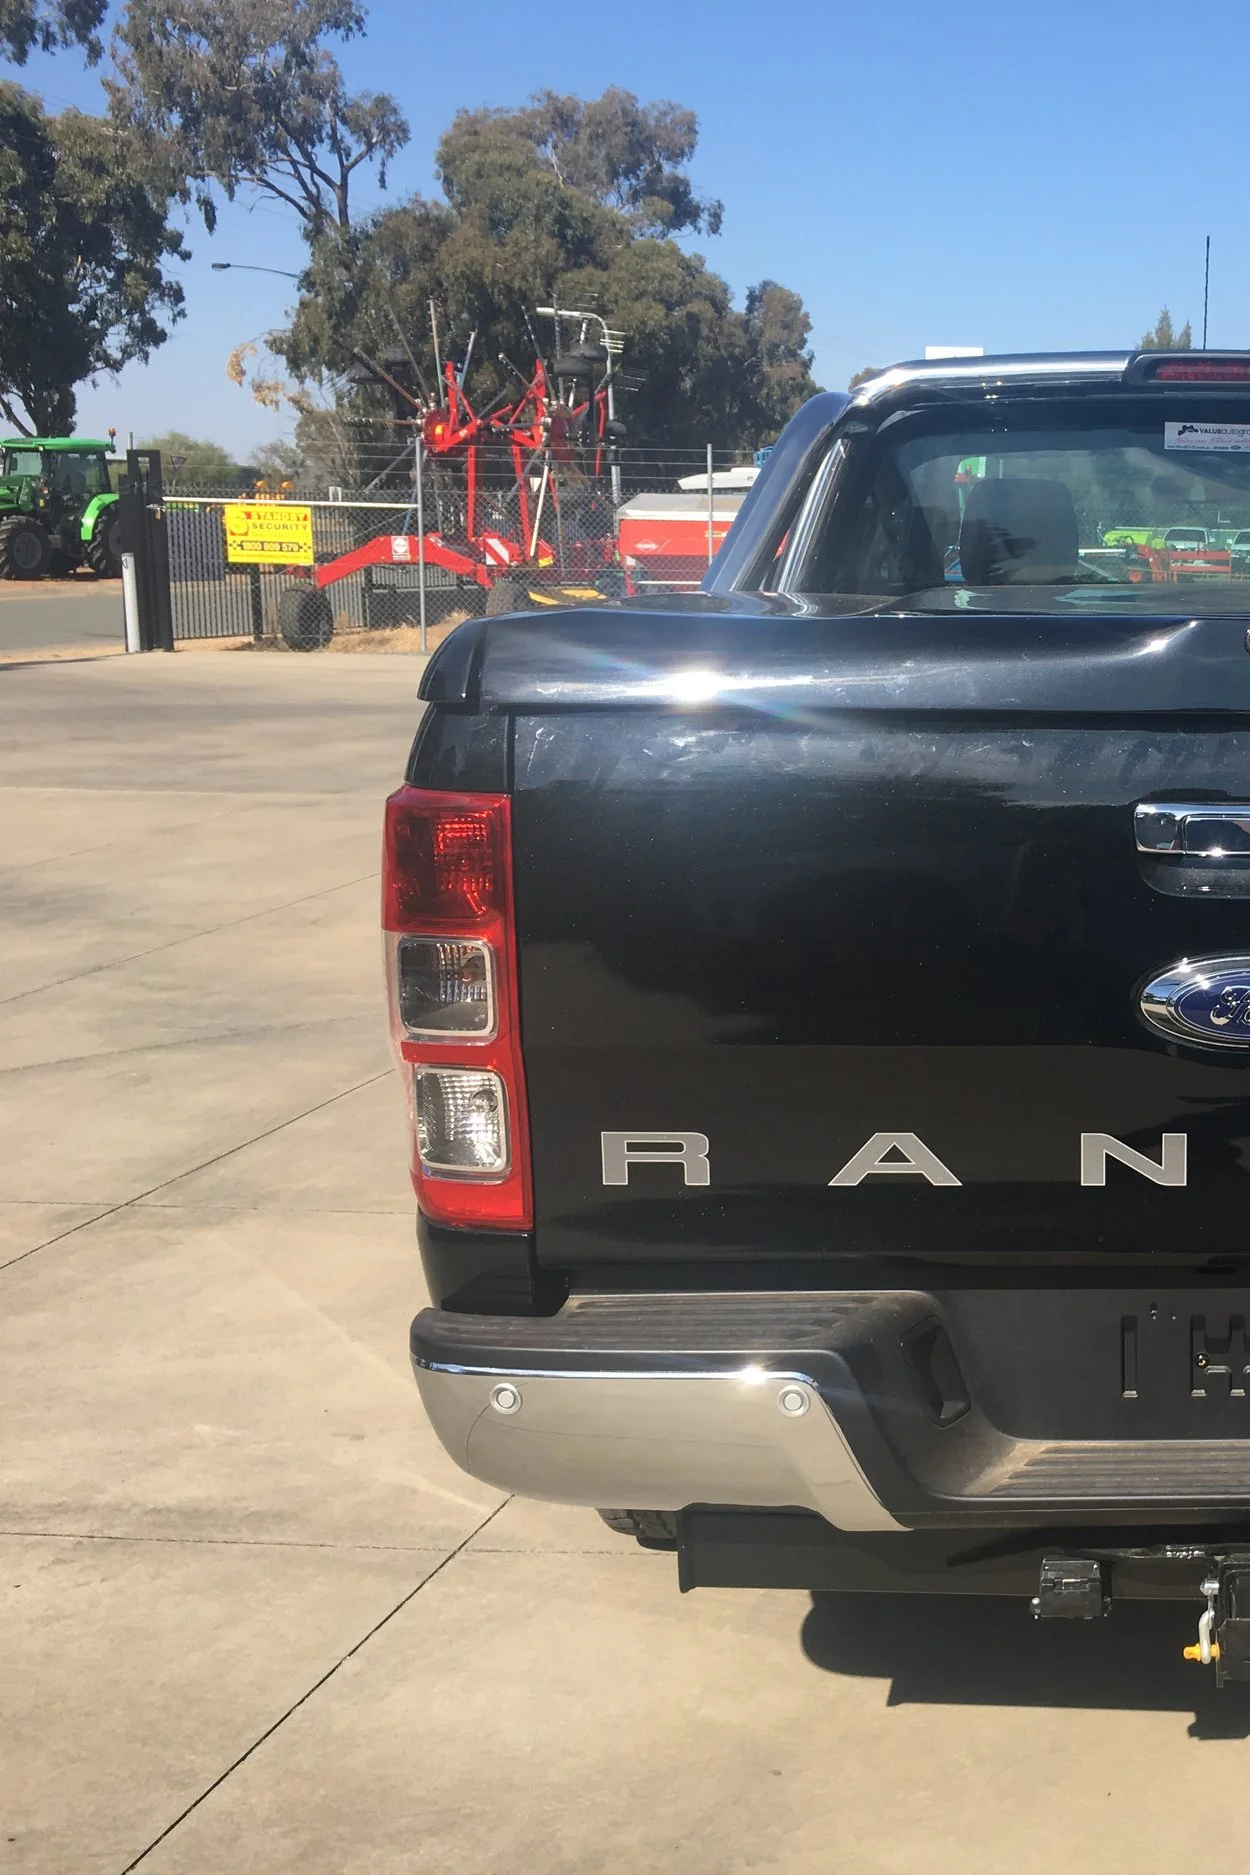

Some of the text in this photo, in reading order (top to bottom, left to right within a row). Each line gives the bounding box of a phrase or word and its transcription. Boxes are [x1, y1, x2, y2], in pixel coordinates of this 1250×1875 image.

[251, 511, 305, 521] STANDBY
[252, 522, 308, 531] SECURITY
[242, 541, 262, 551] 1800
